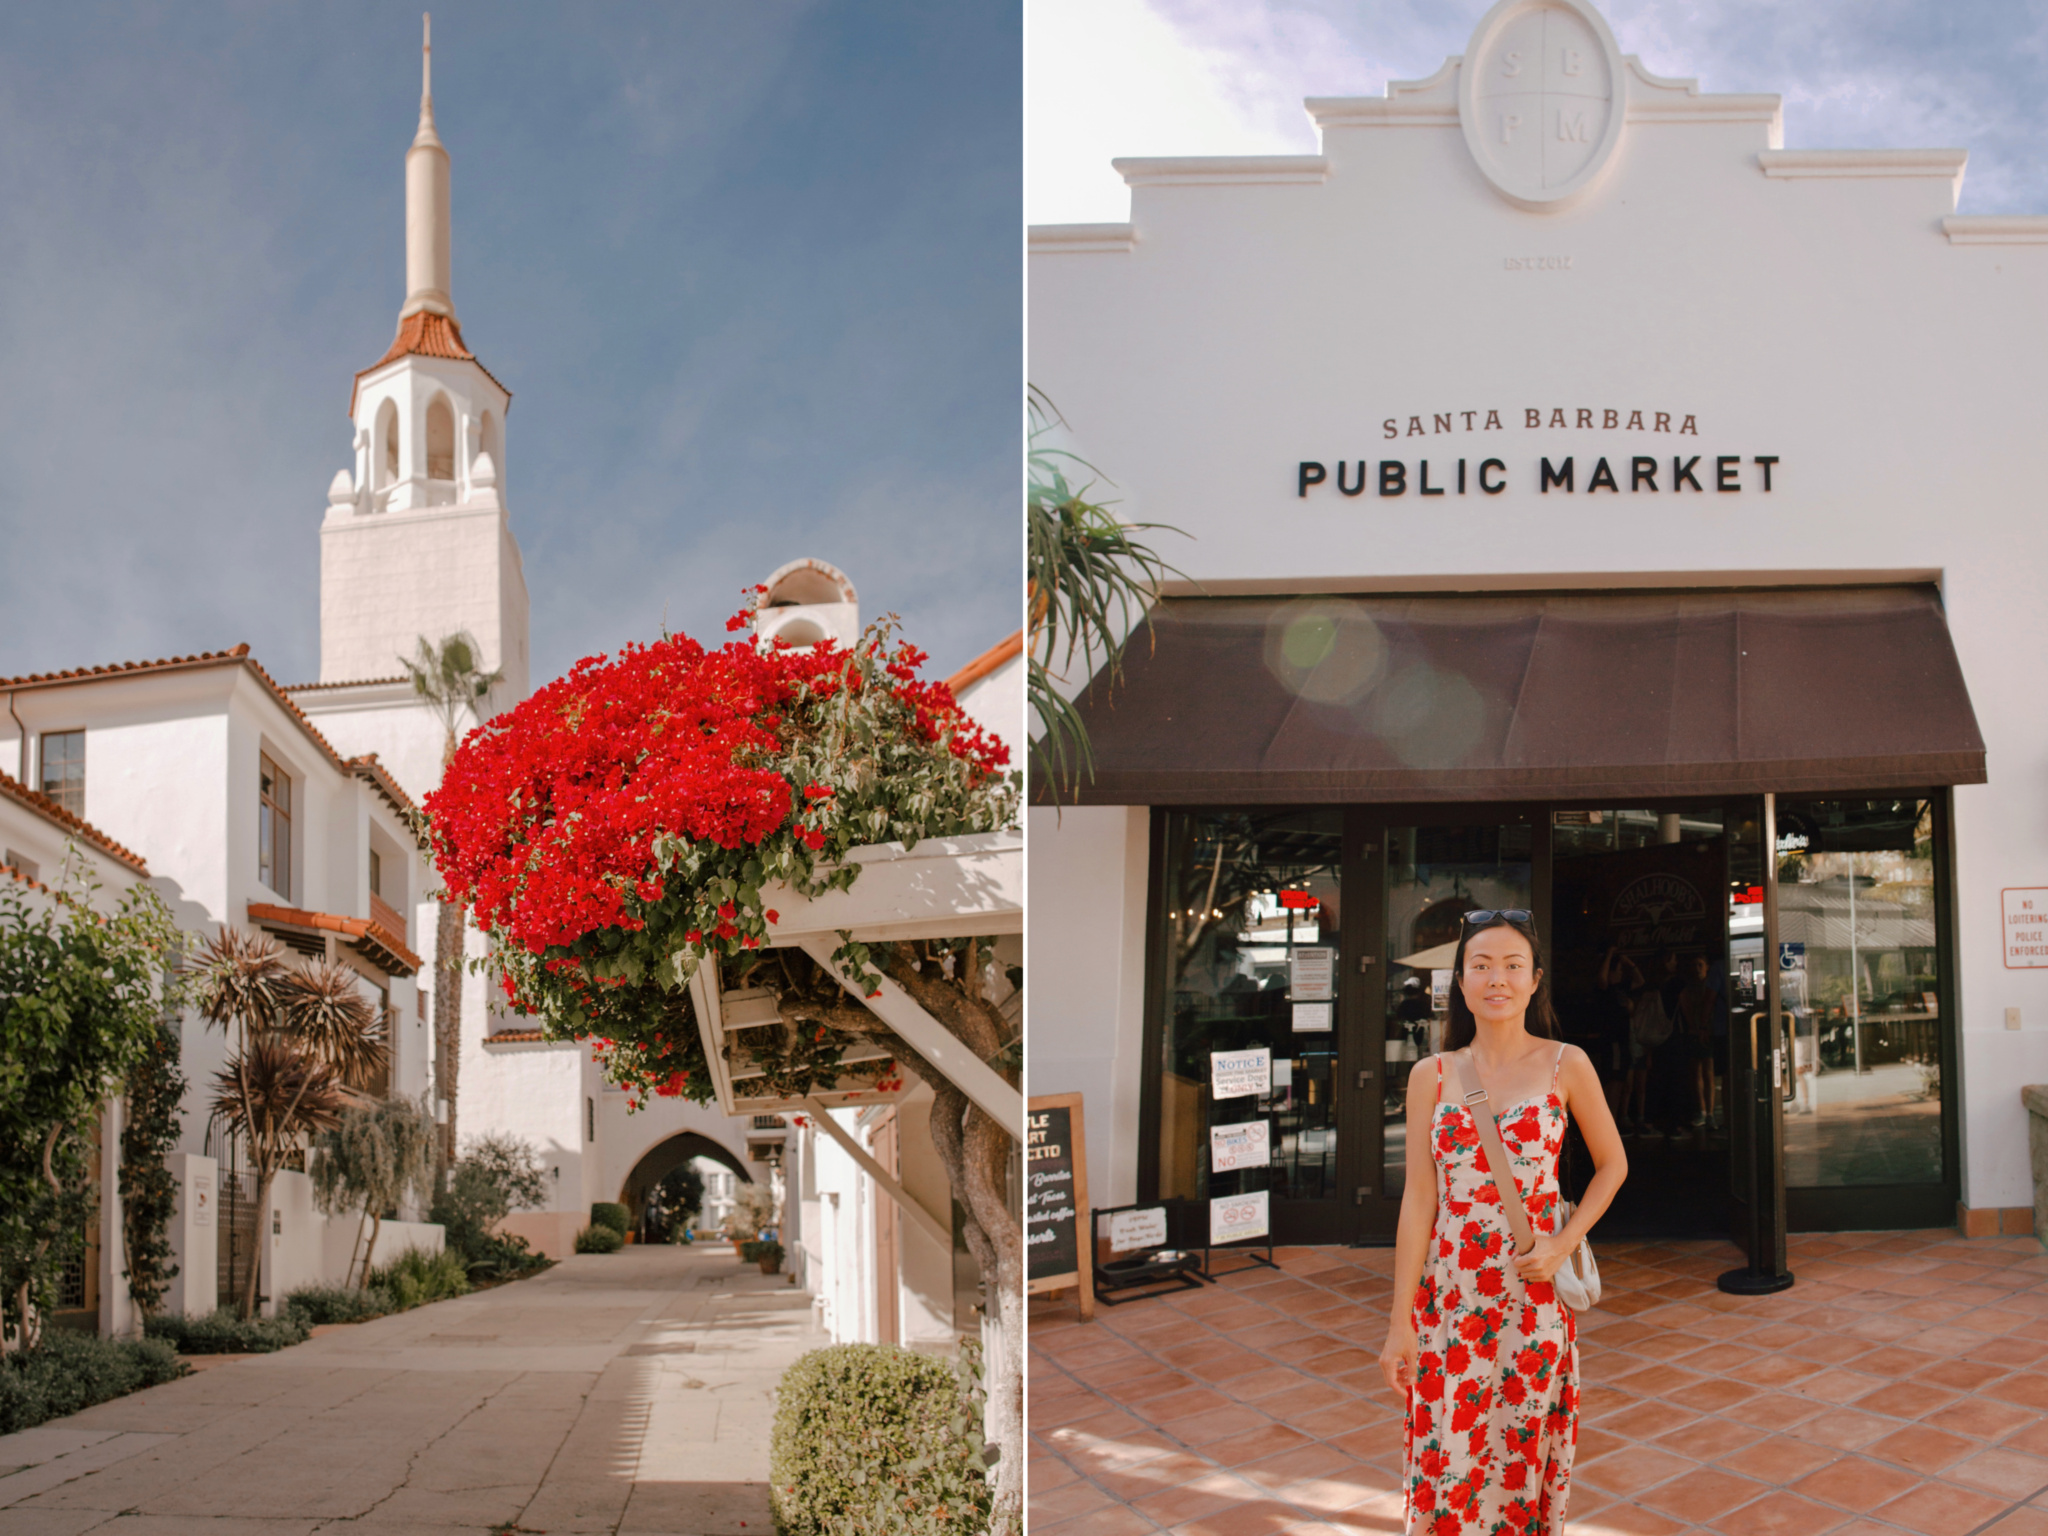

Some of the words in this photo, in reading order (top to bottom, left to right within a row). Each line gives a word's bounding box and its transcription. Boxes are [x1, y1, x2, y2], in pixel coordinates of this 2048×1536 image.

[1501, 50, 1522, 78] S
[1561, 47, 1585, 77] B
[1499, 112, 1523, 145] P
[1556, 108, 1588, 144] M
[1382, 409, 1503, 440] SANTA
[1524, 407, 1700, 436] BARBARA
[1298, 457, 1508, 498] PUBLIC
[1540, 455, 1781, 493] MARKET
[2022, 901, 2033, 910] NO
[2008, 914, 2048, 925] LOITERING
[2015, 932, 2043, 941] POLICE
[2010, 946, 2048, 957] ENFORCED
[1217, 1056, 1266, 1072] NOTICE
[1247, 1074, 1268, 1083] Dogs
[1028, 1130, 1047, 1145] RT
[1217, 1155, 1237, 1168] NO
